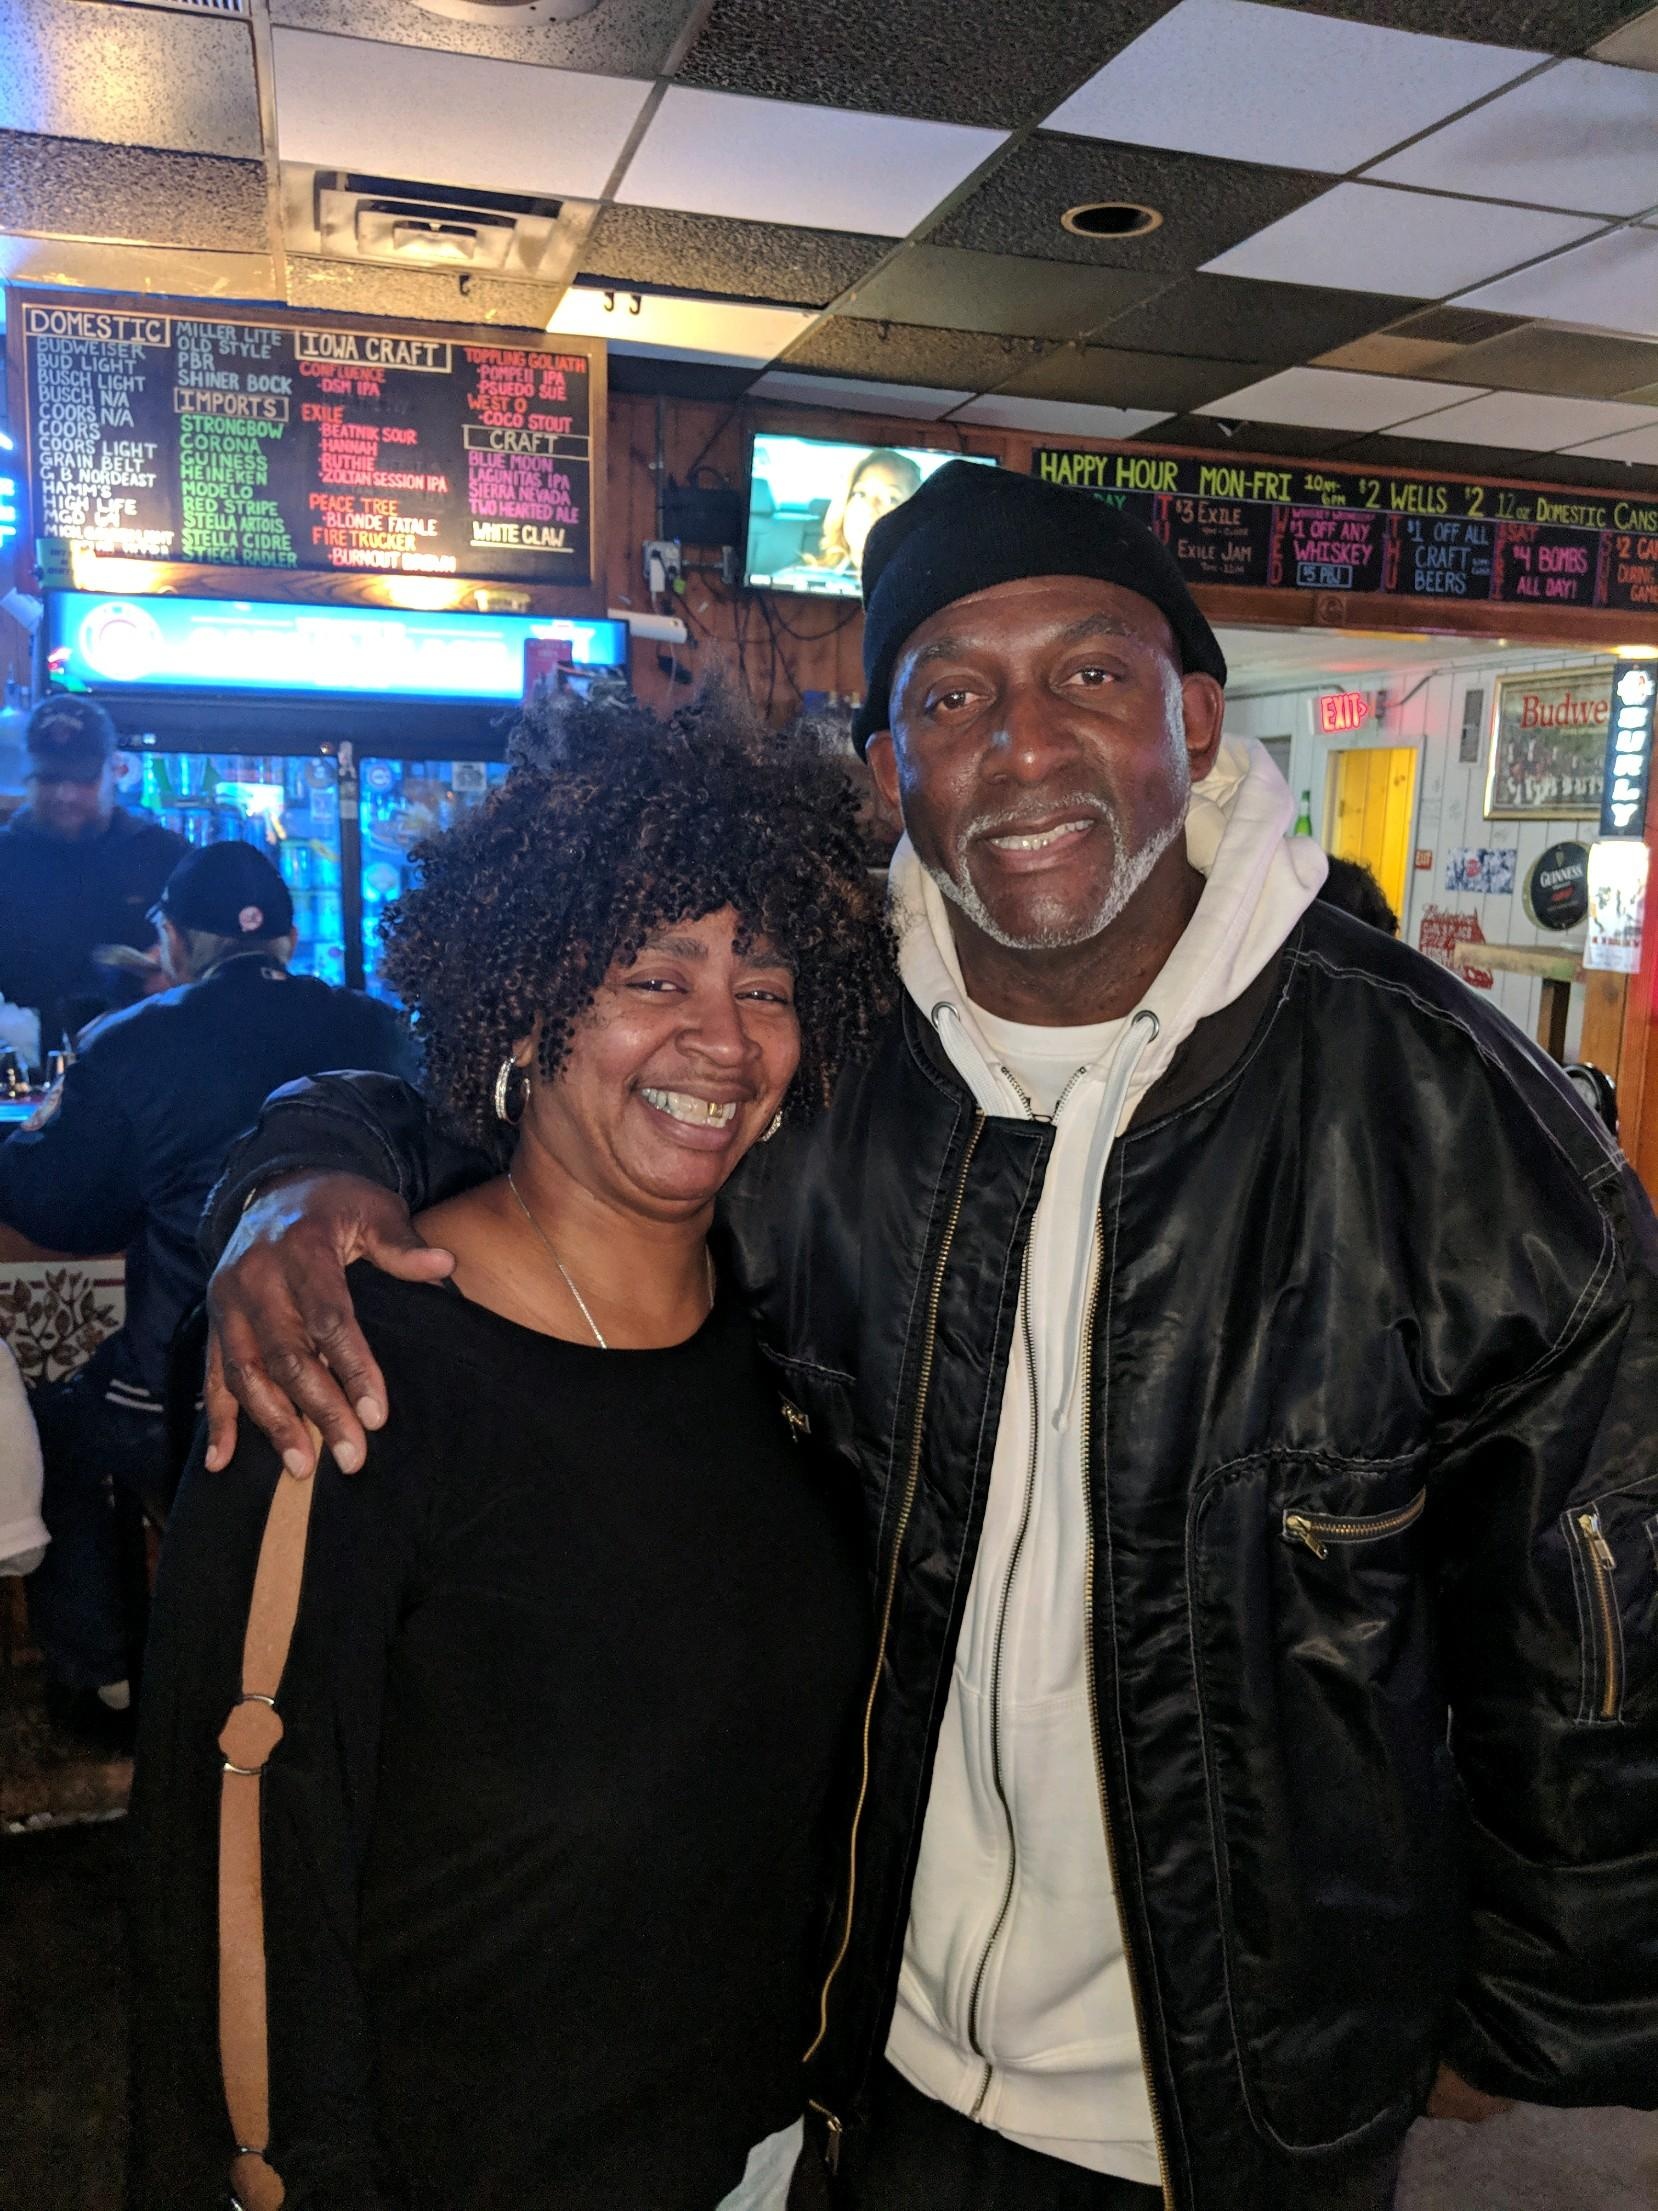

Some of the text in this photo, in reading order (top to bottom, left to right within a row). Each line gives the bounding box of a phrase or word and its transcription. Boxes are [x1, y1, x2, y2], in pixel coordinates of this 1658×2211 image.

[30, 309, 162, 343] DOMESTIC
[176, 321, 282, 346] MILLER LITE
[37, 335, 146, 360] BUDWEISER
[177, 335, 271, 359] OLD STYLE
[302, 332, 440, 367] IOWA CRAFT
[37, 353, 136, 375] BUD LIGHT
[178, 352, 215, 371] PBR
[464, 347, 586, 373] TOPPLING GOLIATH
[37, 368, 146, 392] BUSCH LIGHT
[178, 369, 293, 395] SHINER BOCK
[299, 361, 386, 383] CONFLUENCE
[543, 371, 566, 387] IPA
[38, 385, 130, 408] BUSCH N/A
[357, 382, 380, 397] IPA
[539, 385, 567, 401] SUE
[180, 390, 277, 418] IMPORTS
[301, 403, 344, 424] EXILE
[466, 393, 528, 414] WEST O
[39, 403, 134, 428] COORS N/A
[180, 414, 284, 439] STRONGBOW
[528, 413, 573, 434] STOUT
[38, 420, 101, 440] COORS
[382, 427, 418, 445] SOUR
[39, 437, 158, 459] COORS LIGHT
[180, 433, 262, 454] CORONA
[489, 430, 559, 454] CRAFT
[40, 452, 145, 473] GRAIN BELT
[180, 450, 268, 471] GUINESS
[469, 451, 553, 472] BLUE MOON
[40, 466, 157, 488] G B NORDEAST
[180, 465, 268, 486] HEINEKEN
[373, 471, 424, 491] SESSION
[427, 475, 448, 493] IPA
[469, 467, 570, 490] LAGUNITAS IPA
[1040, 452, 1108, 486] HAPPY
[1116, 457, 1178, 492] HOUR
[1200, 466, 1292, 502] MON-FRI
[1390, 481, 1447, 514] WELLS
[42, 481, 112, 498] HAMM'S
[182, 481, 253, 499] MODELO
[469, 481, 571, 506] SIERRA NEVADA
[43, 495, 137, 515] HIGH LIFE
[183, 496, 279, 516] RED STRIPE
[309, 493, 398, 516] PEACE TREE
[469, 499, 579, 524] TWO HEARTED ALE
[43, 509, 86, 525] MGD
[183, 511, 285, 534] STELLA ARTOIS
[388, 517, 438, 536] FATALE
[182, 528, 238, 547] STELLA
[242, 534, 292, 550] CIDRE
[473, 521, 566, 547] WHITE CLAW
[1310, 521, 1337, 539] OFF
[1341, 522, 1371, 542] ANY
[1433, 521, 1460, 543] OFF
[1465, 525, 1489, 545] ALL
[1293, 540, 1373, 566] WHISKEY
[1415, 545, 1472, 572] CRAFT
[1538, 546, 1588, 574] BOMBS
[1414, 569, 1467, 595] BEERS
[1516, 576, 1540, 596] ALL
[1321, 692, 1360, 732] EXIT
[1520, 690, 1608, 730] Budwe
